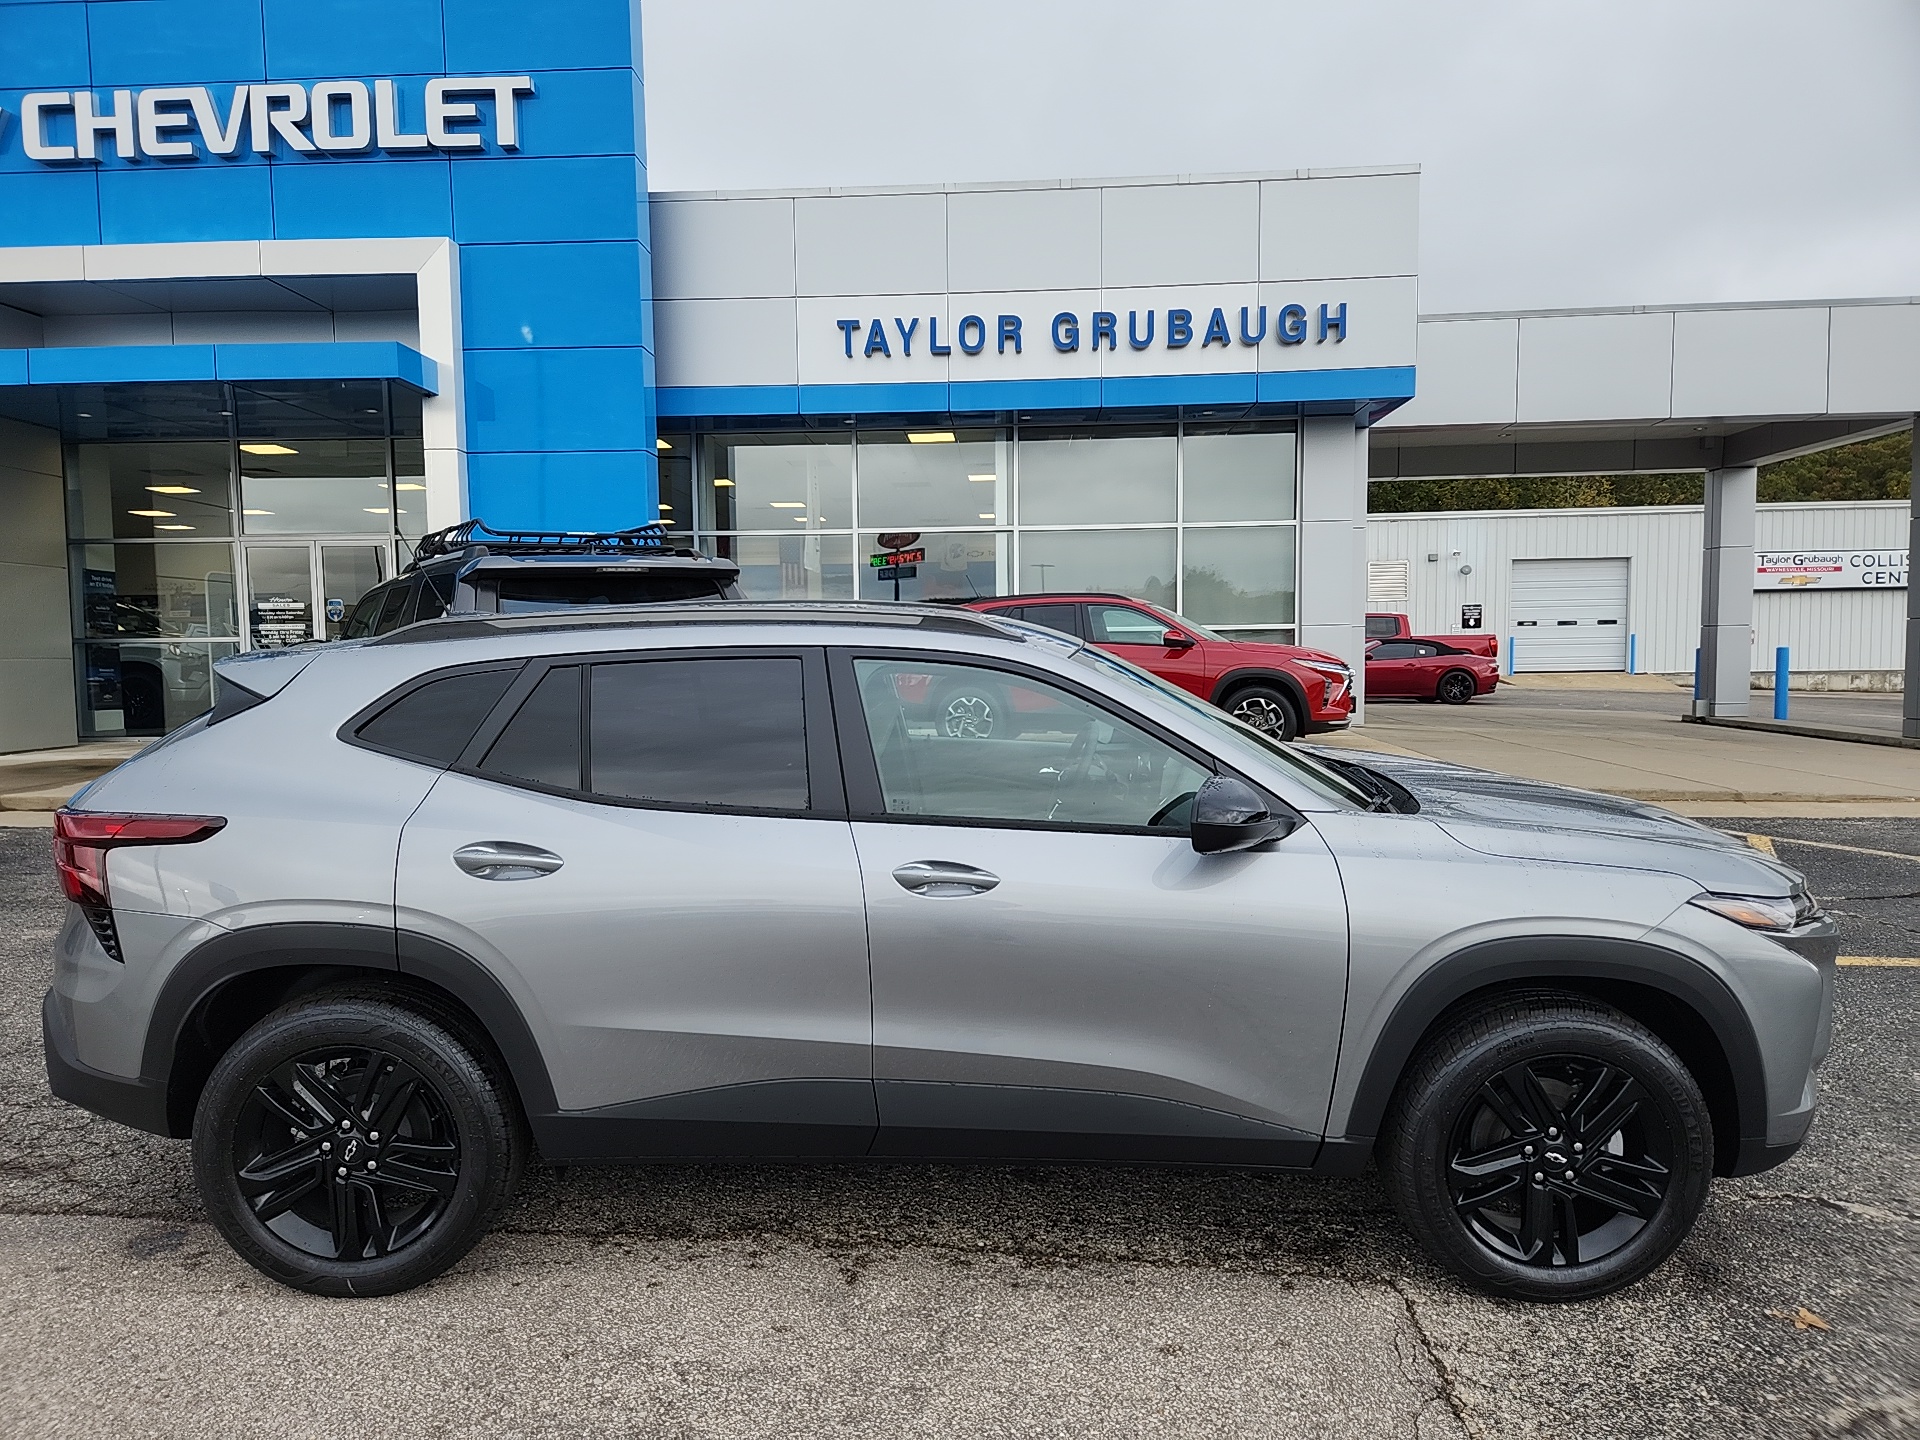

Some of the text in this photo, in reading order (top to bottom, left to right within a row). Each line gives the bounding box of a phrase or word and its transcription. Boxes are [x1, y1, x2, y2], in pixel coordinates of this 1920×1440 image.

[21, 75, 533, 160] CHEVROLET
[836, 303, 1348, 358] TAYLOR GRUBAUGH
[1757, 554, 1844, 566] Taylor Grubaugh
